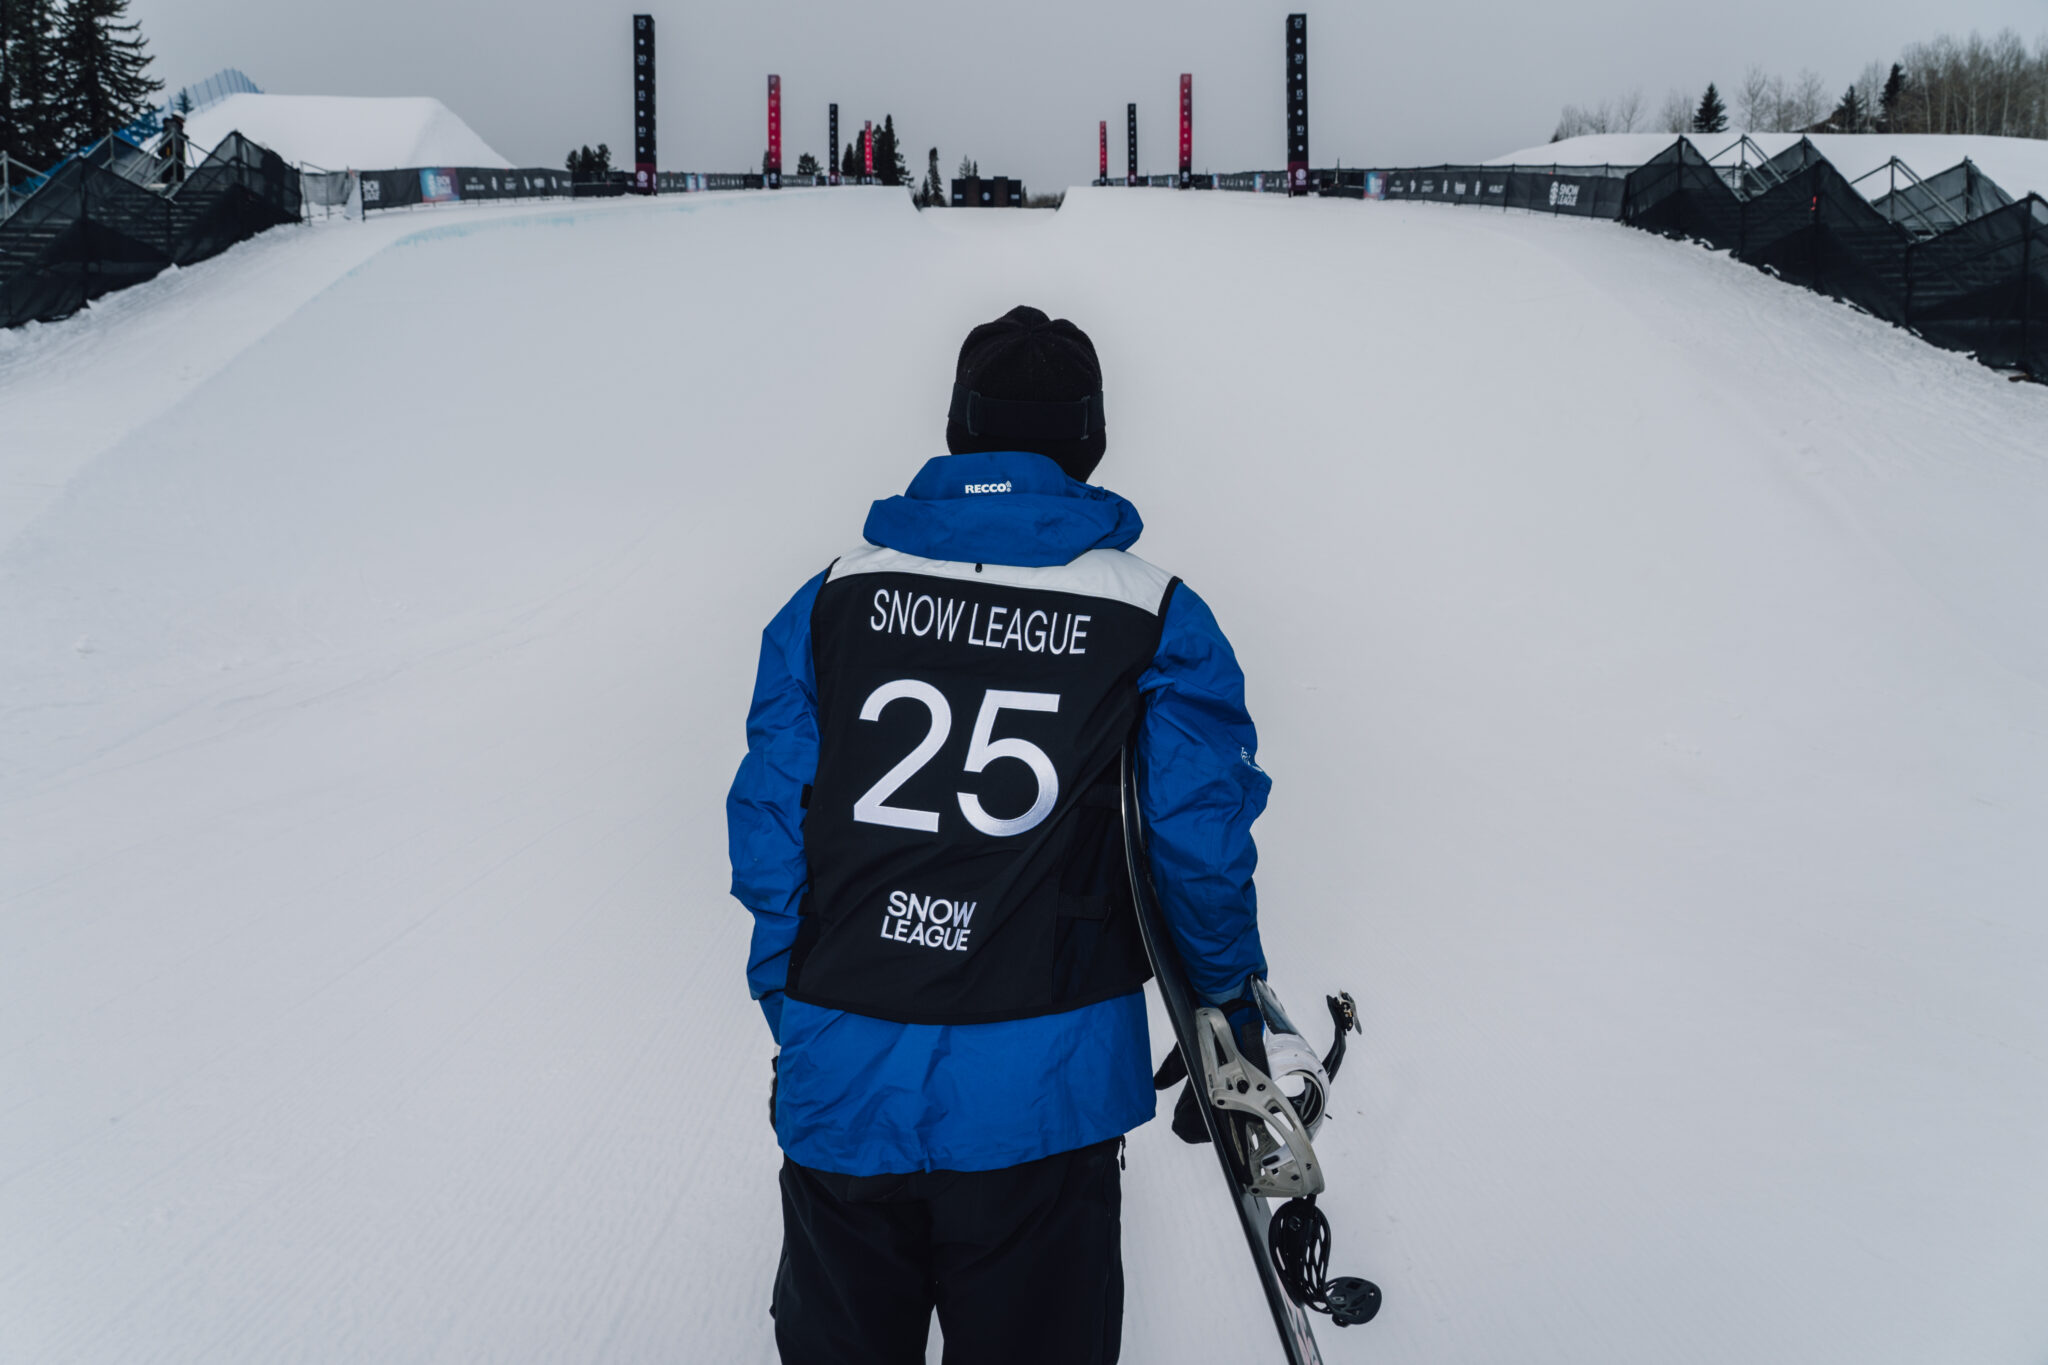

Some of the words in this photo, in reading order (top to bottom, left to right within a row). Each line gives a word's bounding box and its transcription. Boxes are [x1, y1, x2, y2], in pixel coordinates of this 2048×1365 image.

[1559, 184, 1580, 195] SNOW
[965, 483, 1007, 494] RECCO
[871, 589, 966, 642] SNOW
[968, 603, 1092, 655] LEAGUE
[853, 679, 1061, 837] 25
[887, 890, 977, 928] SNOW
[880, 915, 971, 951] LEAGUE
